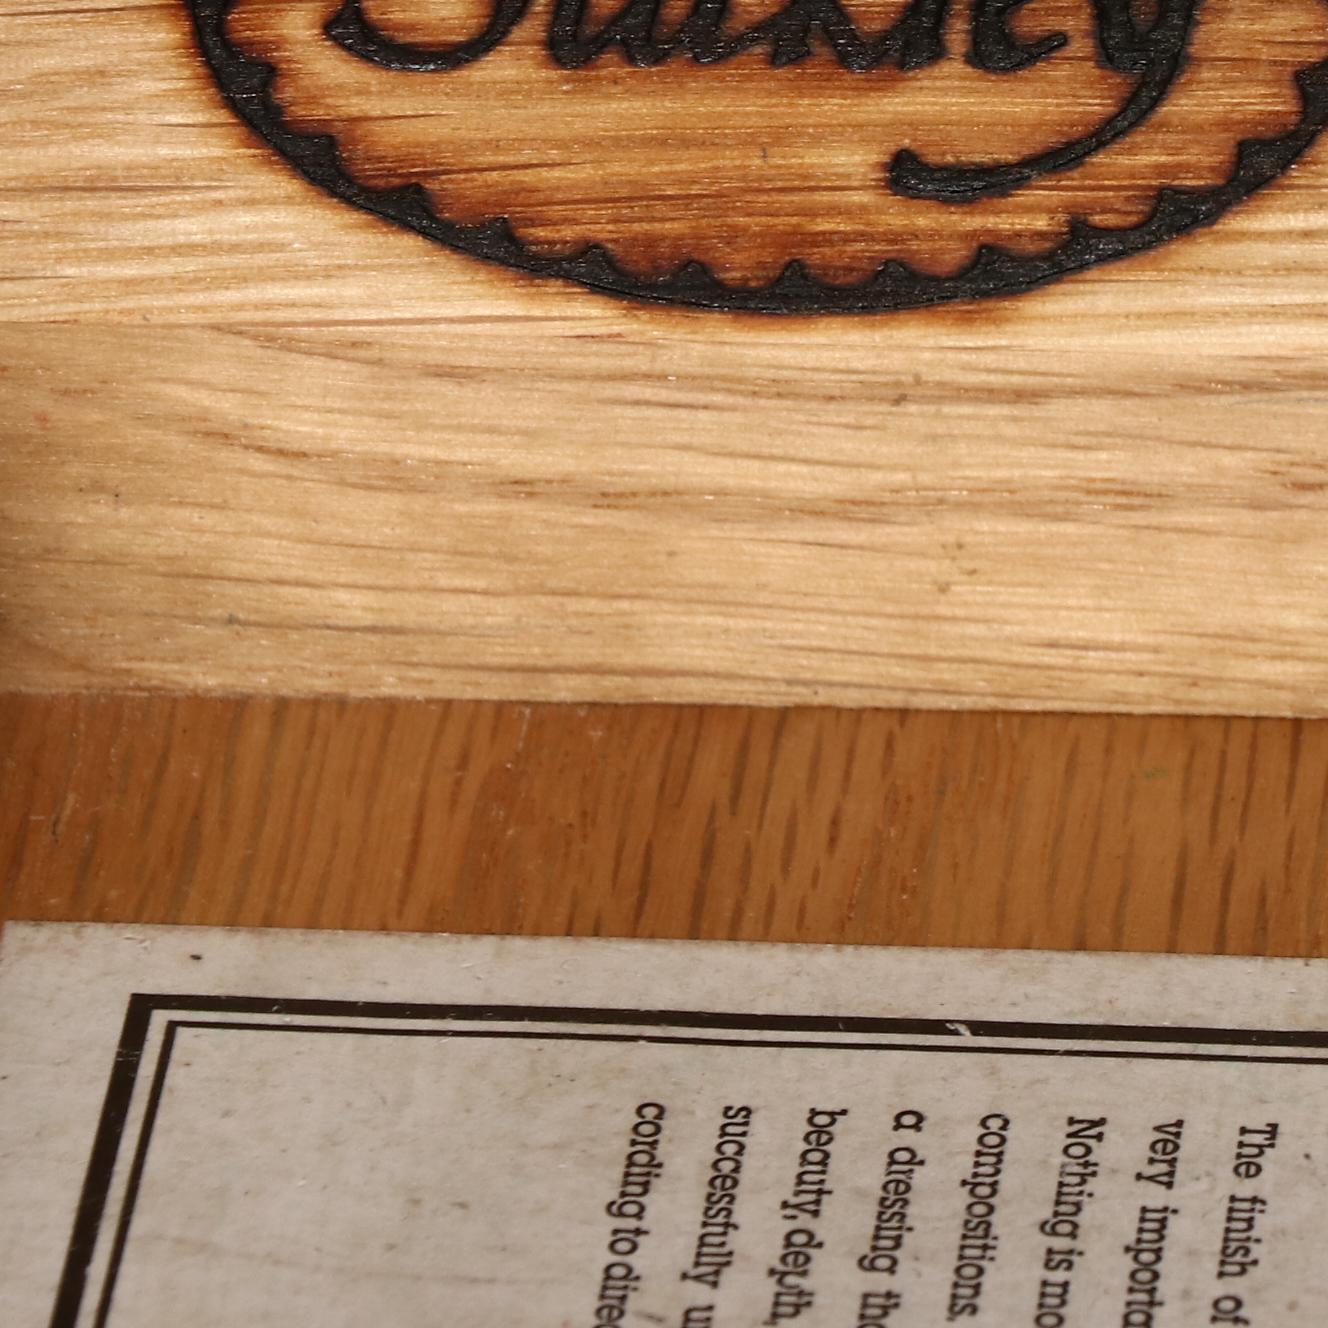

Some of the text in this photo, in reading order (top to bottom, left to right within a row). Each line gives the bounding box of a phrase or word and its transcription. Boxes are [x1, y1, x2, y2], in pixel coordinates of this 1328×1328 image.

[592, 1101, 666, 1328] cording to dire
[680, 1104, 752, 1290] successfully
[762, 1107, 849, 1327] beauty, depth,
[856, 1108, 926, 1328] a dressing th
[946, 1112, 1011, 1323] compositions.
[1039, 1116, 1108, 1241] Nothing
[1135, 1118, 1185, 1191] very
[1210, 1122, 1279, 1328] The finish of
[1042, 1246, 1085, 1273] is
